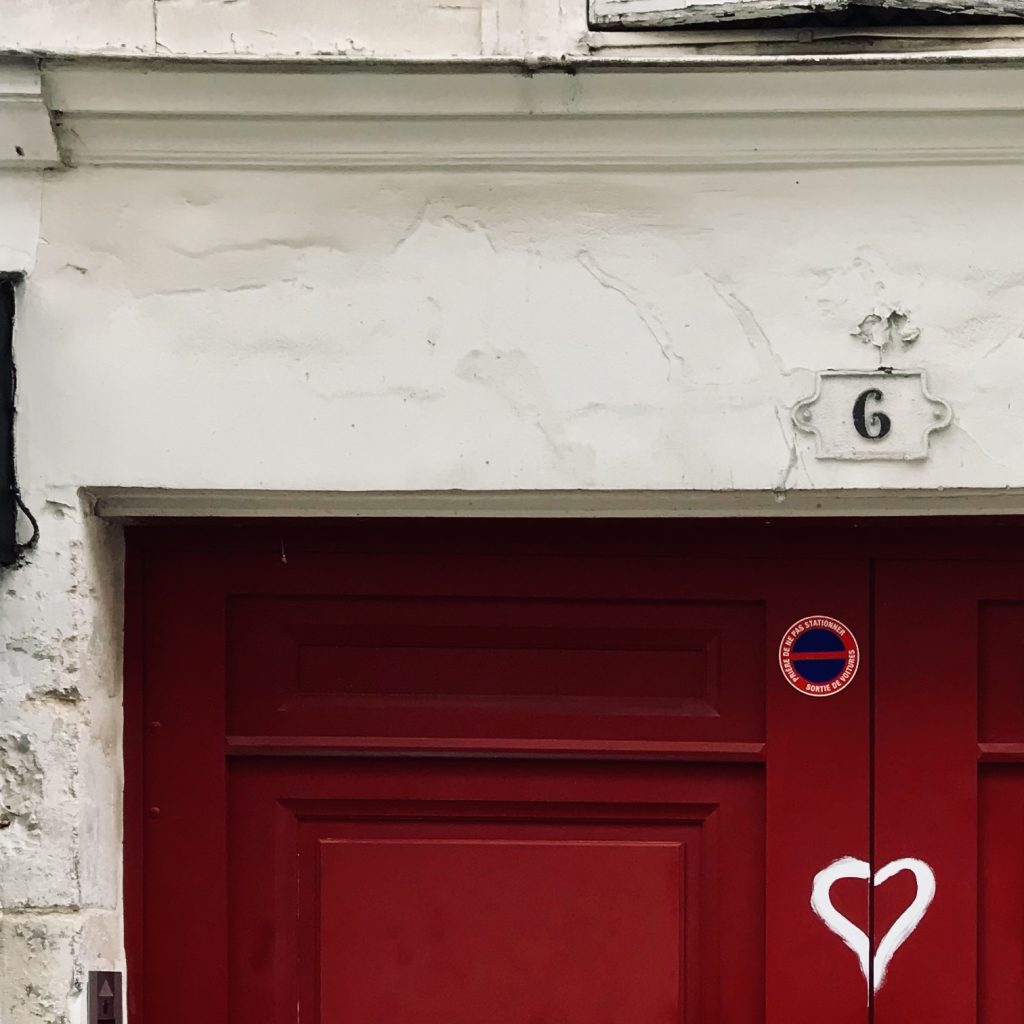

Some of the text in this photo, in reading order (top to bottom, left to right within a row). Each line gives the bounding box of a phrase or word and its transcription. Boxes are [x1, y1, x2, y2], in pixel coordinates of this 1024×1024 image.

[852, 388, 891, 439] 6
[791, 625, 804, 637] PAS
[804, 619, 845, 636] STATIONNER
[785, 636, 794, 646] NE
[783, 647, 790, 656] DE
[806, 649, 855, 692] SORTIE DE VOITURES
